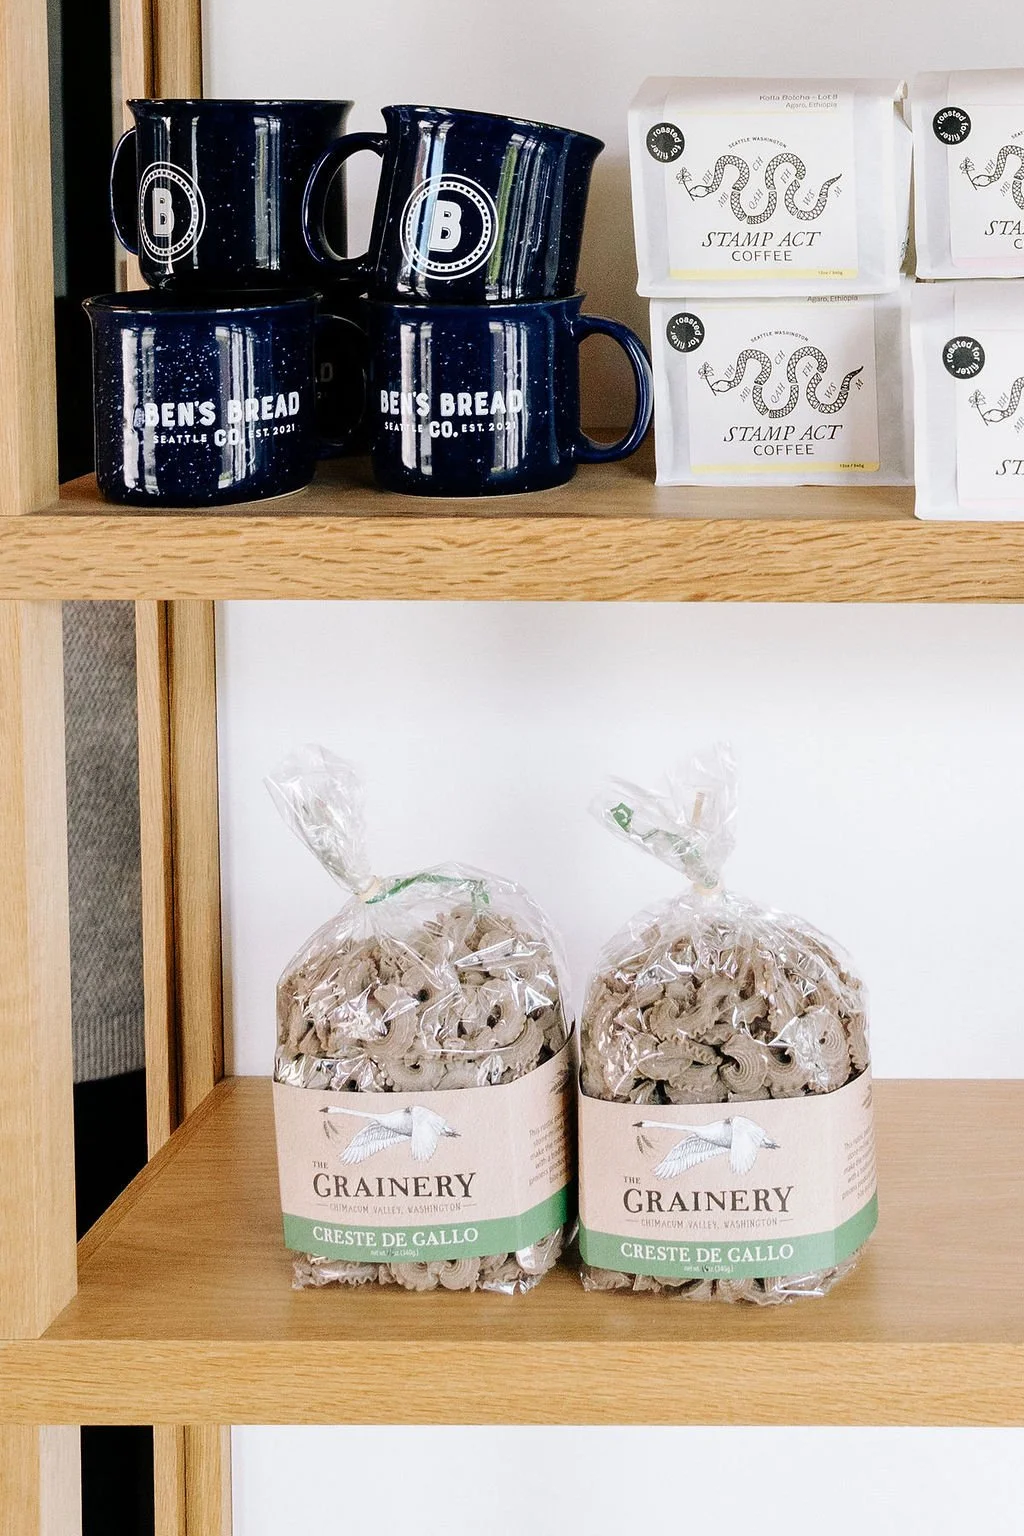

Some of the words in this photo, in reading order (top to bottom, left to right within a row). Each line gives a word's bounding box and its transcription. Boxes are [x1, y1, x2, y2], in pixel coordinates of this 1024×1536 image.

[152, 187, 175, 237] B
[428, 200, 463, 252] B
[702, 232, 775, 247] STAMP
[777, 231, 822, 247] ACT
[731, 250, 793, 262] COFFEE
[143, 401, 216, 428] BEN'S
[227, 391, 300, 424] BREAD
[380, 390, 431, 416] BEN'S
[440, 390, 524, 417] BREAD
[153, 434, 208, 445] SEATTLE
[269, 423, 296, 435] 2021
[429, 421, 459, 438] CO.
[462, 423, 485, 433] EST.
[489, 422, 517, 432] 2021
[723, 425, 796, 442] STAMP
[799, 424, 842, 440] ACT
[753, 444, 815, 456] COFFEE
[312, 1160, 329, 1170] THE
[312, 1172, 477, 1199] GRAINERY
[623, 1175, 641, 1184] THE
[329, 1203, 369, 1214] CHIMACUM
[407, 1202, 461, 1214] WASHINGTON
[623, 1186, 794, 1214] GRAINERY
[641, 1218, 684, 1229] CHIMACUM
[724, 1217, 778, 1229] WASHINGTON
[312, 1226, 377, 1247] CRESTE
[382, 1232, 408, 1247] DE
[412, 1227, 479, 1247] GALLO
[620, 1242, 691, 1263] CRESTE
[696, 1247, 722, 1263] DE
[728, 1243, 794, 1262] GALLO
